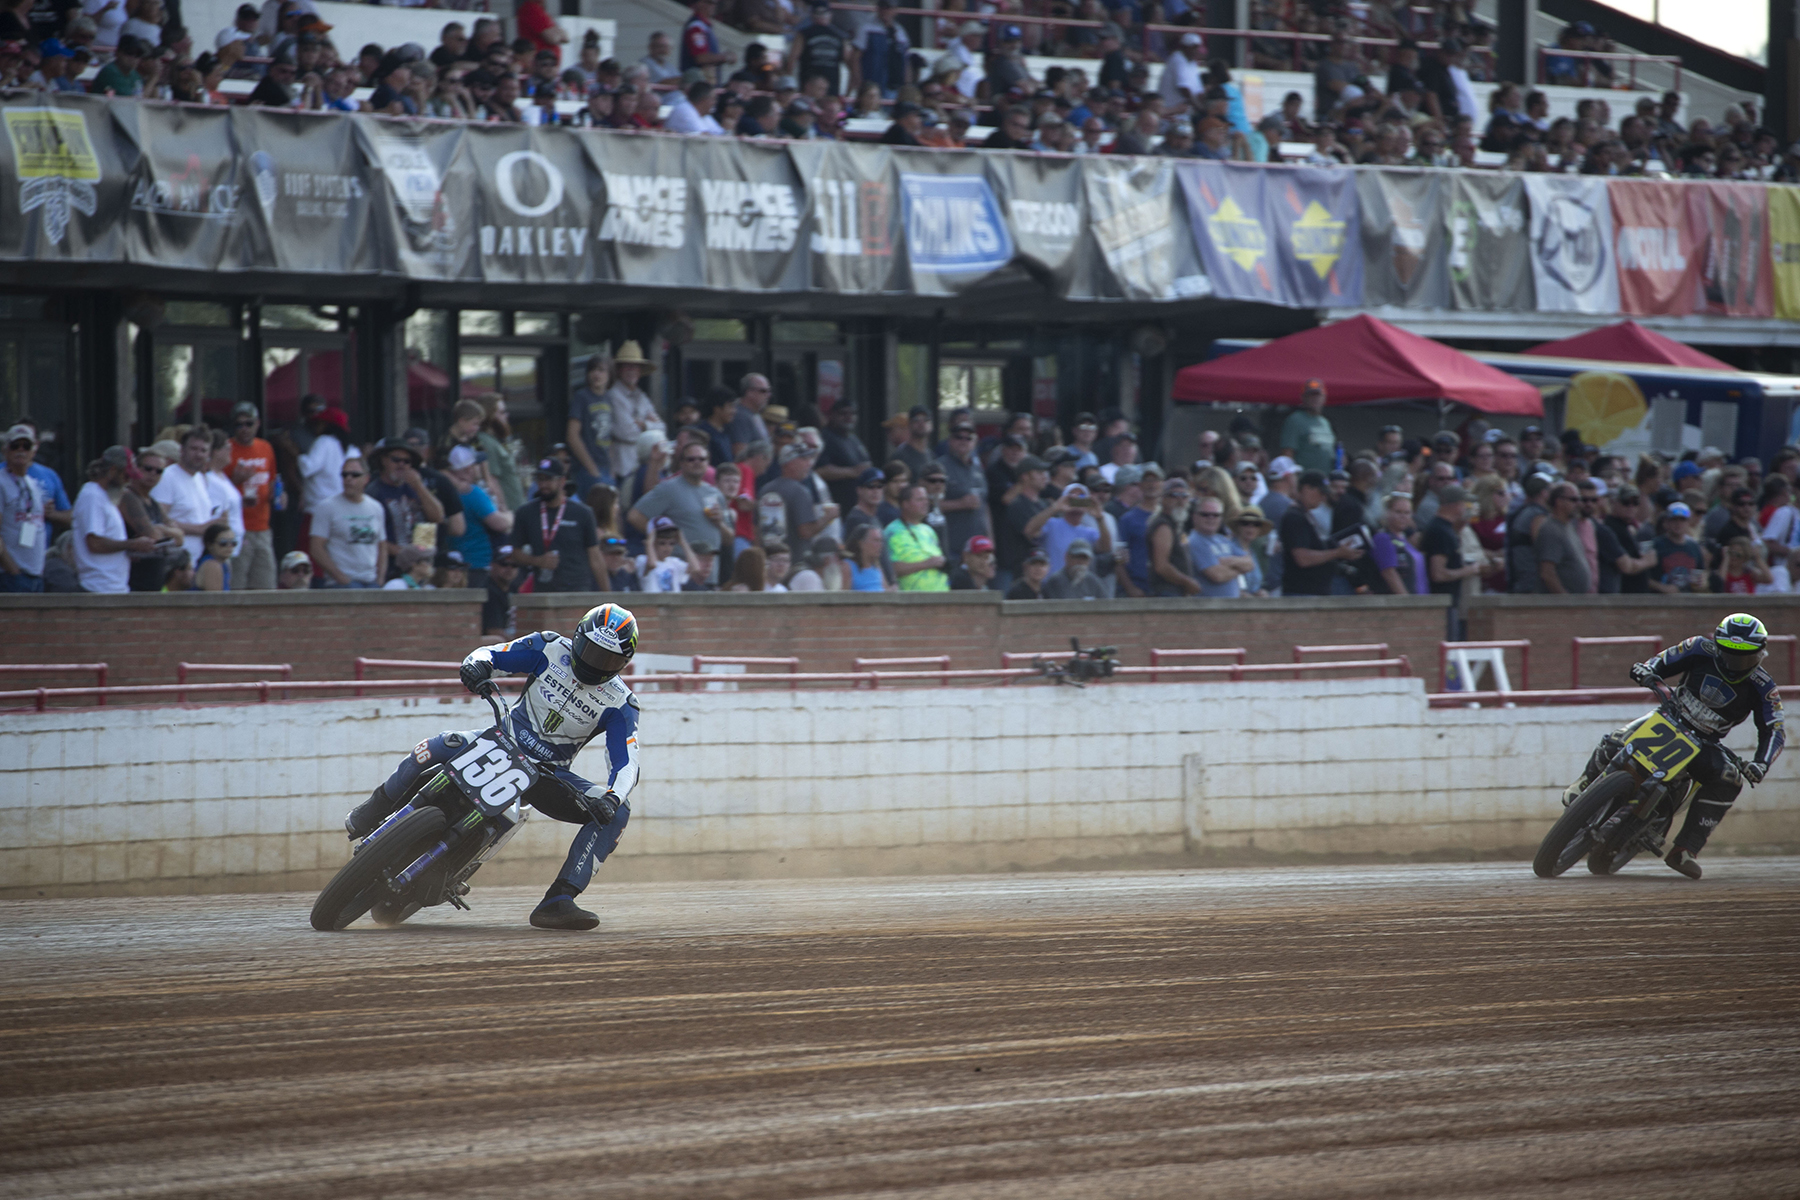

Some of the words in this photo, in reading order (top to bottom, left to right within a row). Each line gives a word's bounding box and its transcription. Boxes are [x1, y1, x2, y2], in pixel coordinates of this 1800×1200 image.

[480, 225, 588, 257] OAKLEY
[543, 673, 598, 720] ESTENSON
[552, 699, 591, 726] Racing
[526, 734, 555, 759] YAMAHA
[1633, 722, 1695, 771] 20
[450, 737, 531, 807] 136
[575, 831, 599, 875] DAINESE
